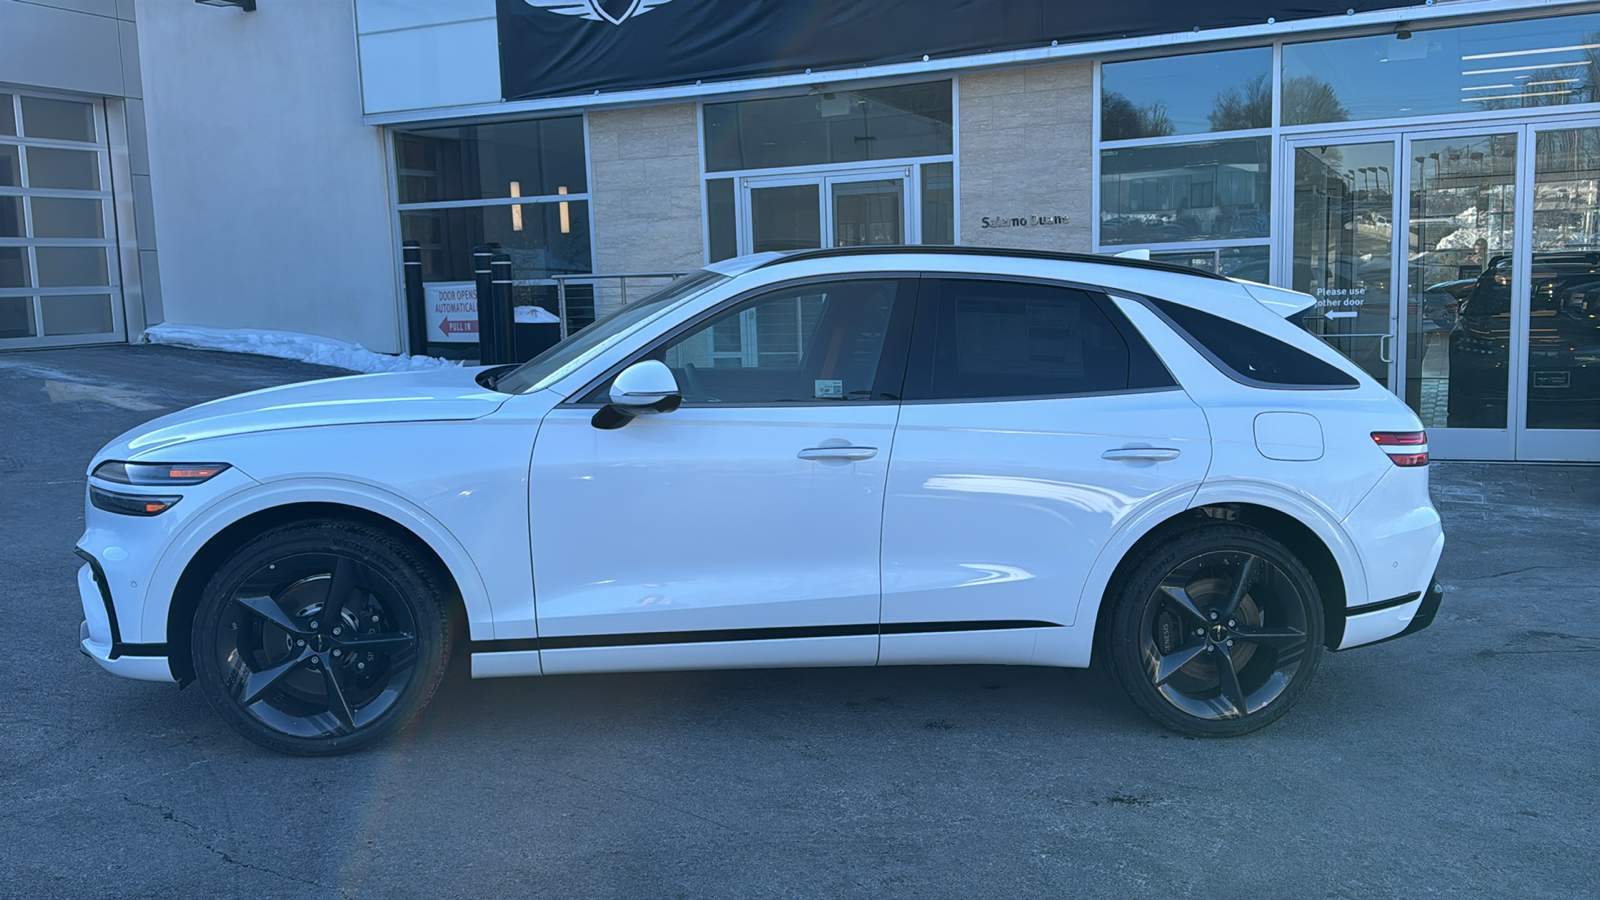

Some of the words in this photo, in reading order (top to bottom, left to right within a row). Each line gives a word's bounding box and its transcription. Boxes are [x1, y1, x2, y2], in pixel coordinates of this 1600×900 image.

[981, 216, 1027, 228] Salerno
[1030, 214, 1070, 226] Duane
[439, 291, 457, 301] DOOR
[457, 289, 477, 300] OPENS
[1317, 288, 1347, 296] Please
[435, 302, 478, 313] AUTOMATICAL
[1317, 298, 1341, 307] other
[1343, 297, 1365, 306] door
[449, 322, 463, 331] PULL
[465, 322, 471, 331] IN
[1162, 623, 1170, 654] GENESIS
